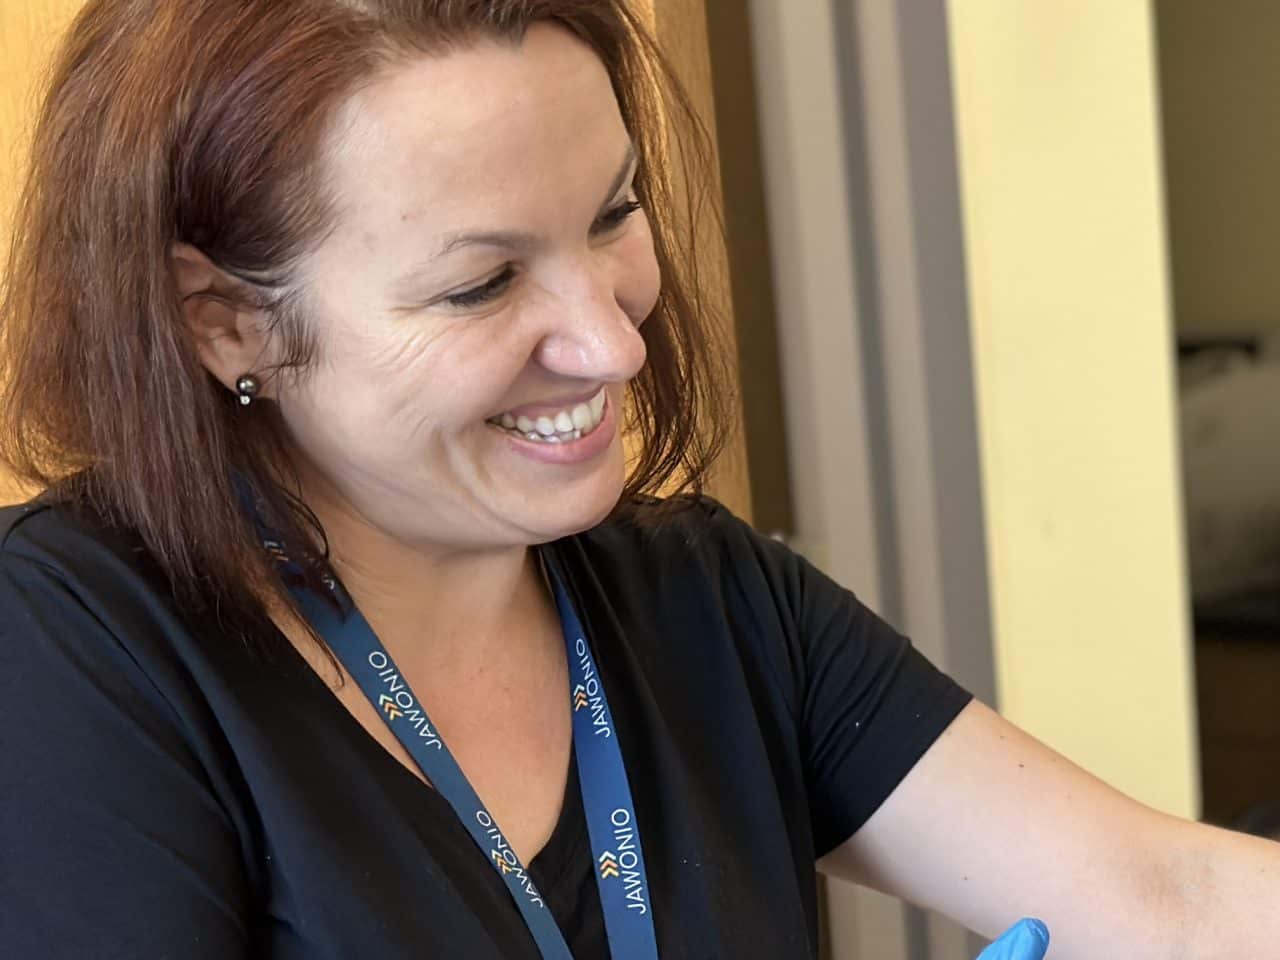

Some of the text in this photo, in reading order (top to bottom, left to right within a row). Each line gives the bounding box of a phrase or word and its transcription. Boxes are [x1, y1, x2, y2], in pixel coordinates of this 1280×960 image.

[368, 650, 442, 750] JAWONIO
[575, 638, 611, 738] JAWONIO
[476, 810, 544, 908] JAWONIO
[611, 808, 647, 914] JAWONIO
